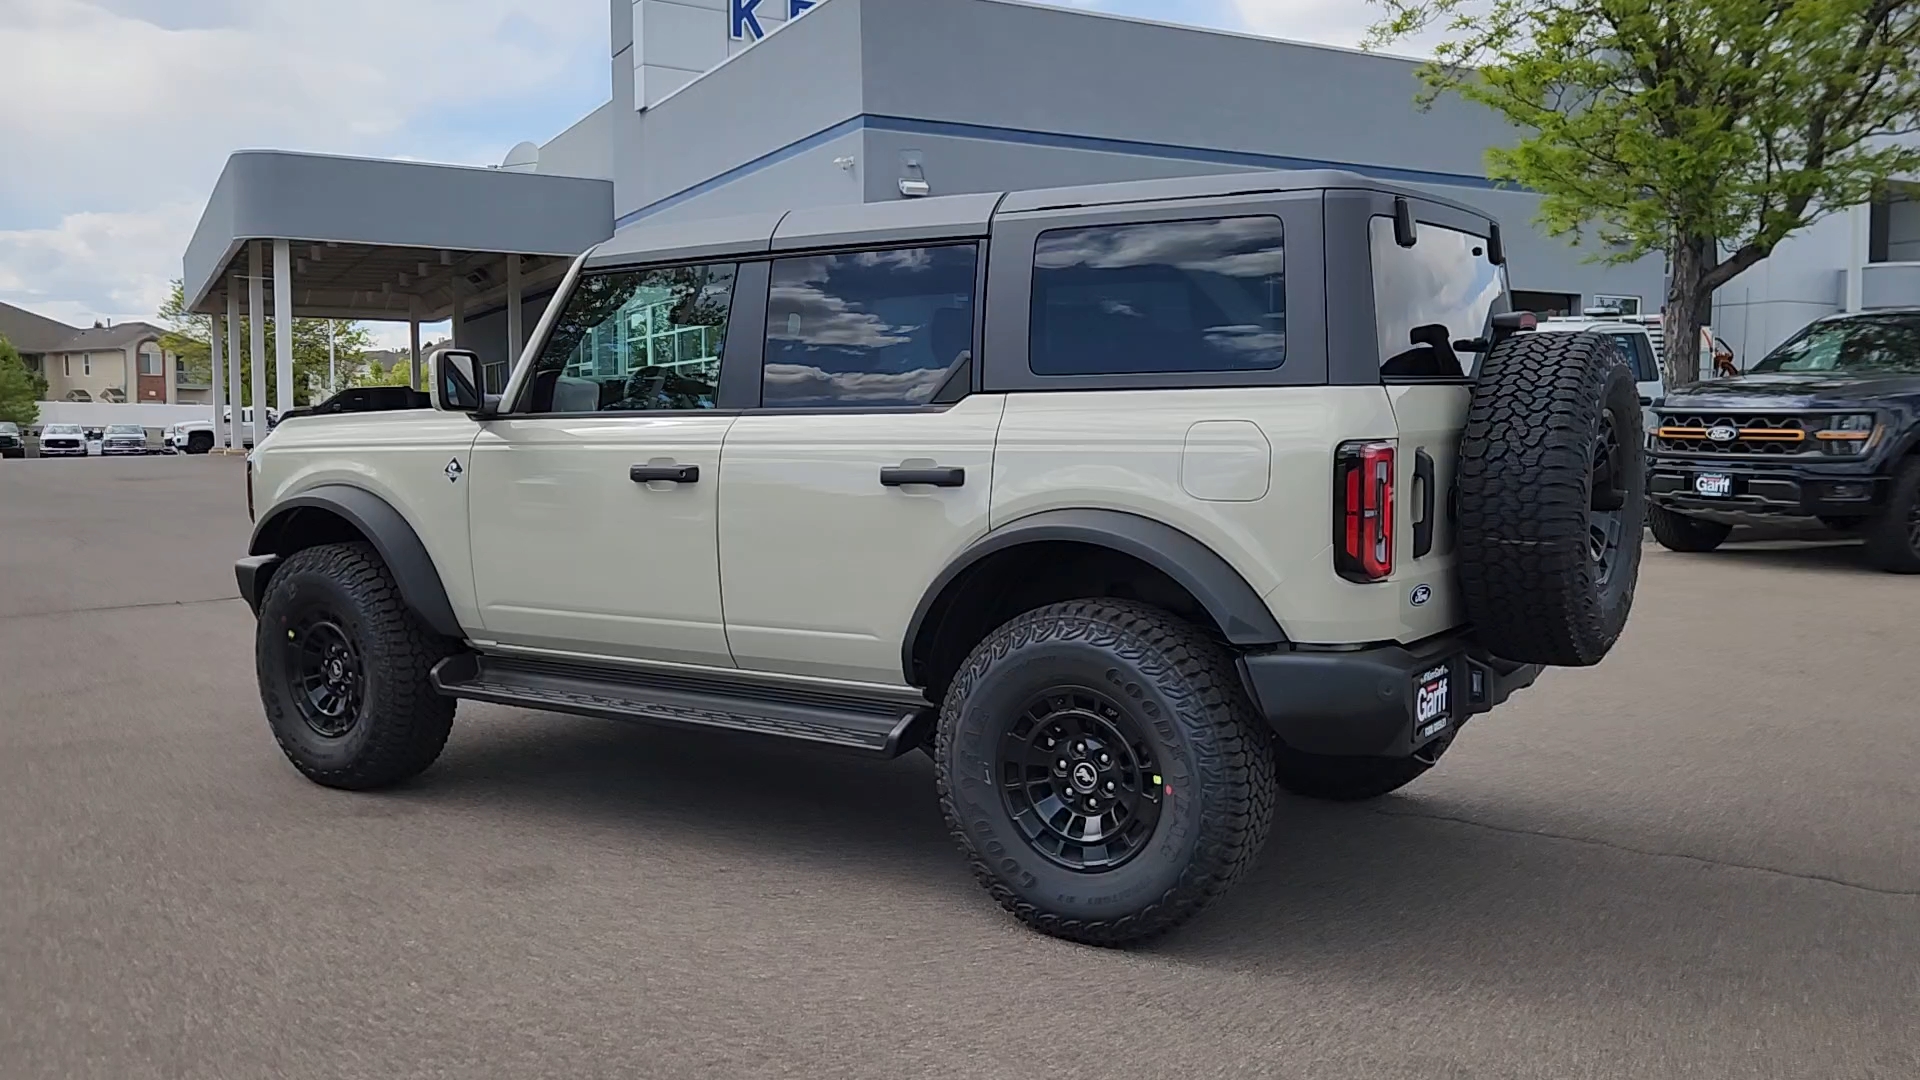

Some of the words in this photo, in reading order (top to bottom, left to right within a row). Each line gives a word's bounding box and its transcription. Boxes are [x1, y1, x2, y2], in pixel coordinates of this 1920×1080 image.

[1696, 476, 1730, 493] Garff
[1414, 587, 1430, 604] Ford
[1416, 678, 1448, 722] Garff
